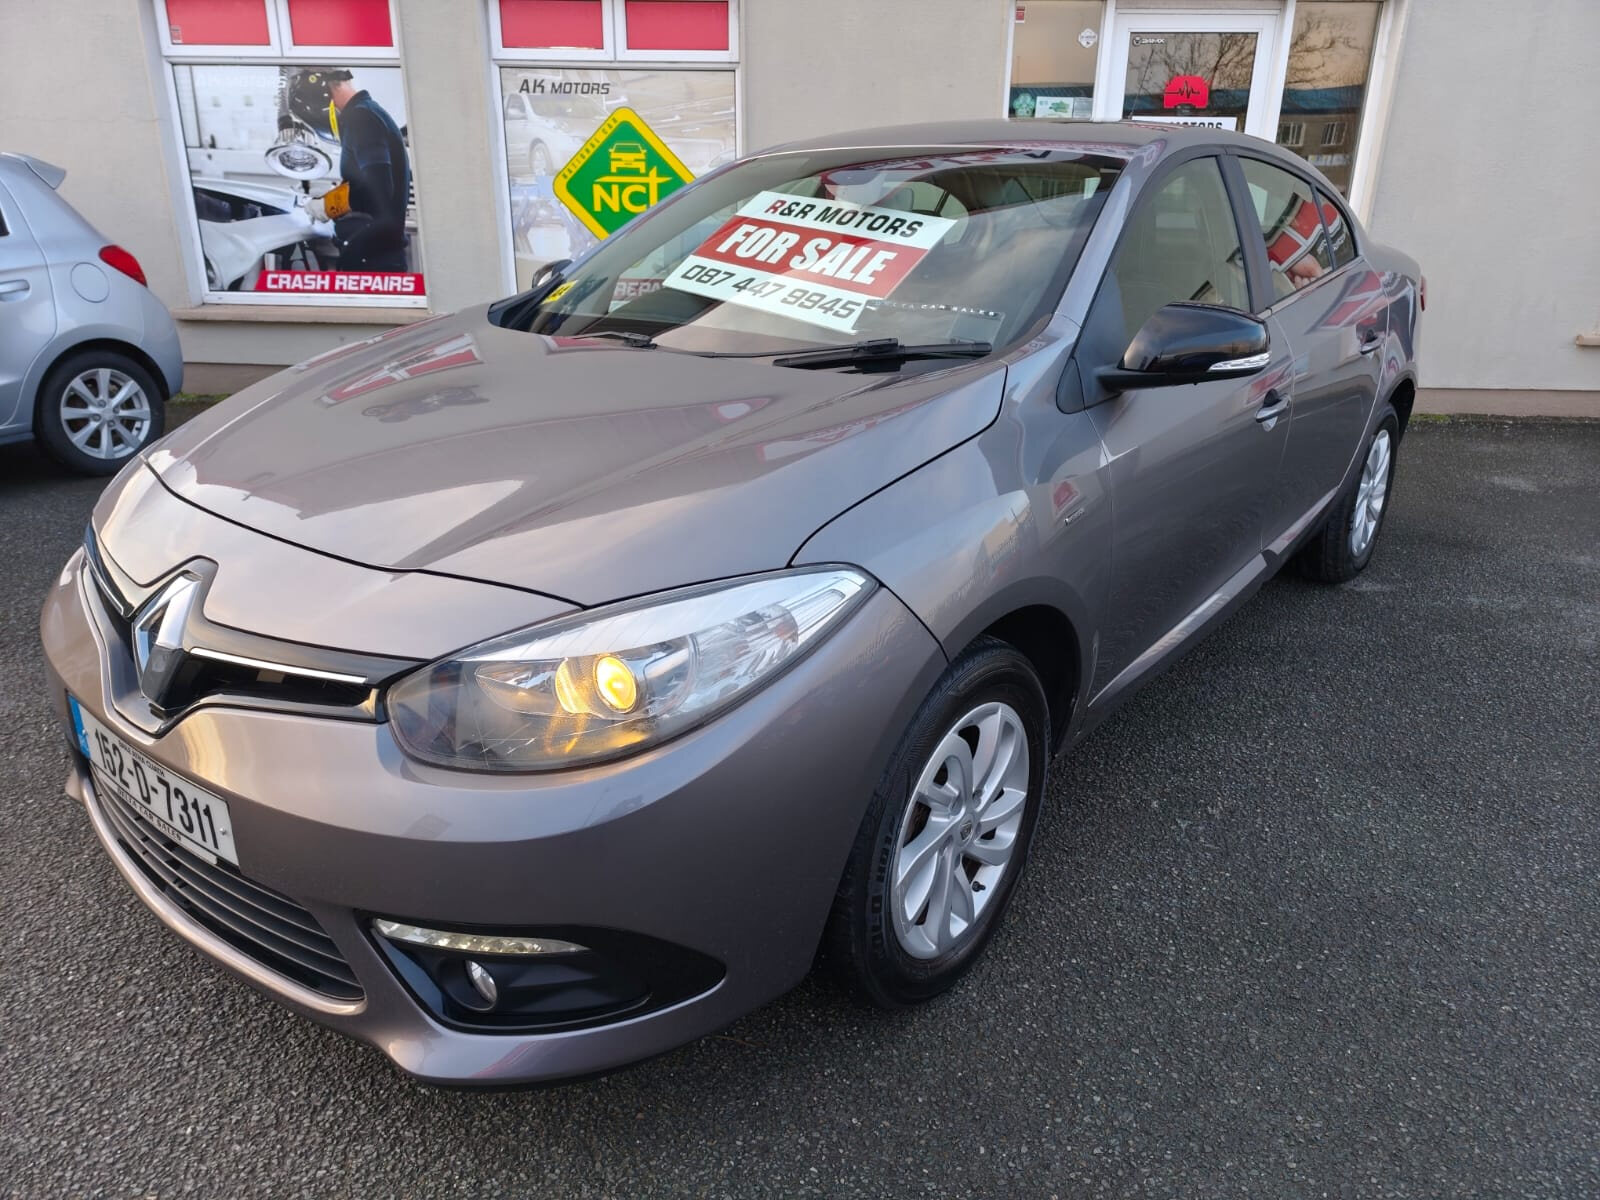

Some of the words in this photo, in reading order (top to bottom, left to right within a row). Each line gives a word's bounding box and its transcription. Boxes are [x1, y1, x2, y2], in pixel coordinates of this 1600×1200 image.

[519, 79, 545, 94] AK
[551, 82, 611, 95] MOTORS
[764, 199, 816, 220] R&R
[814, 206, 923, 239] MOTORS
[716, 223, 800, 266] FOR
[790, 237, 898, 285] SALE
[266, 274, 330, 290] CRASH
[334, 275, 416, 292] REPAIRS
[680, 264, 735, 286] 087
[732, 277, 782, 299] 447
[781, 287, 864, 320] 9945
[95, 728, 219, 850] 152-D-7311
